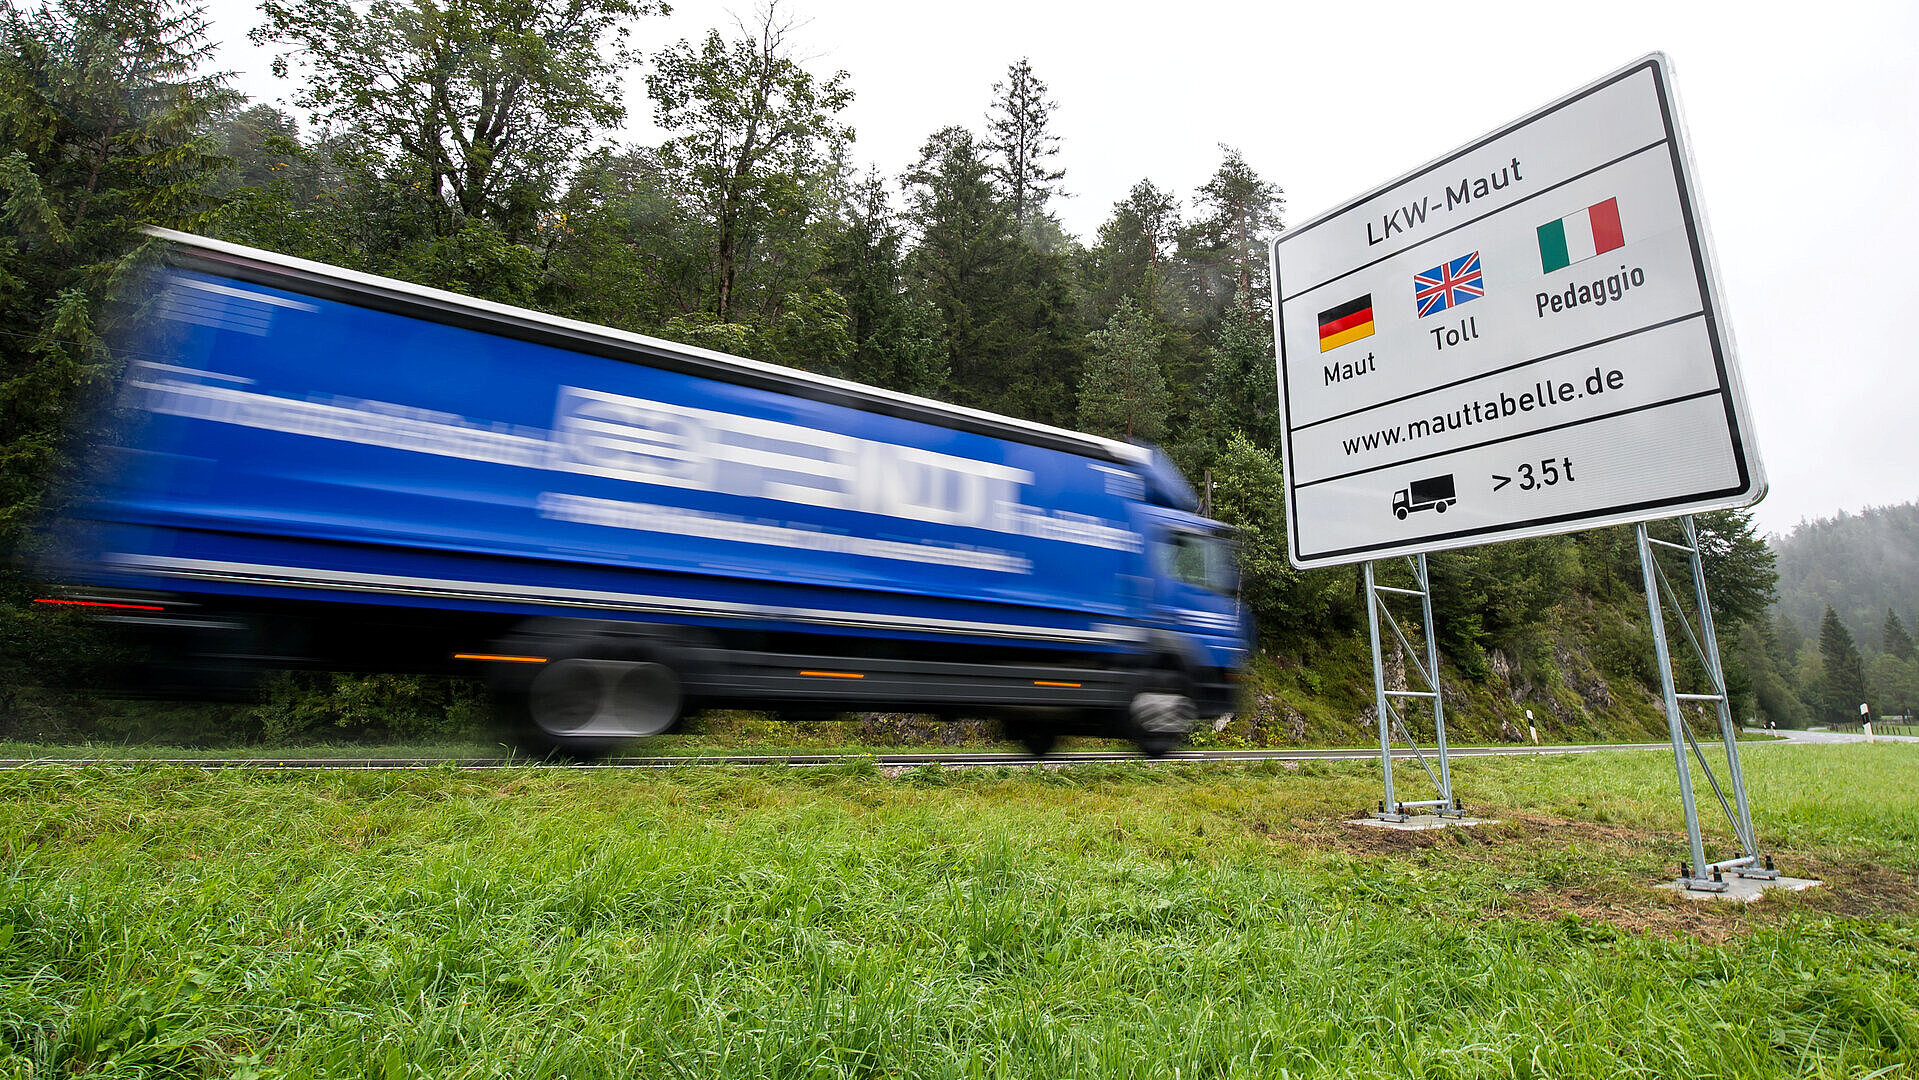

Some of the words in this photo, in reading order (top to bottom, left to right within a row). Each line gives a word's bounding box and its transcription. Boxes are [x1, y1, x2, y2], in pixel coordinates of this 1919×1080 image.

[1367, 158, 1523, 246] LKW-Maut
[1536, 265, 1645, 317] Pedaggio
[1431, 317, 1479, 350] Toll
[1323, 352, 1376, 385] Maut
[1343, 368, 1624, 455] www.mauttabelle.de
